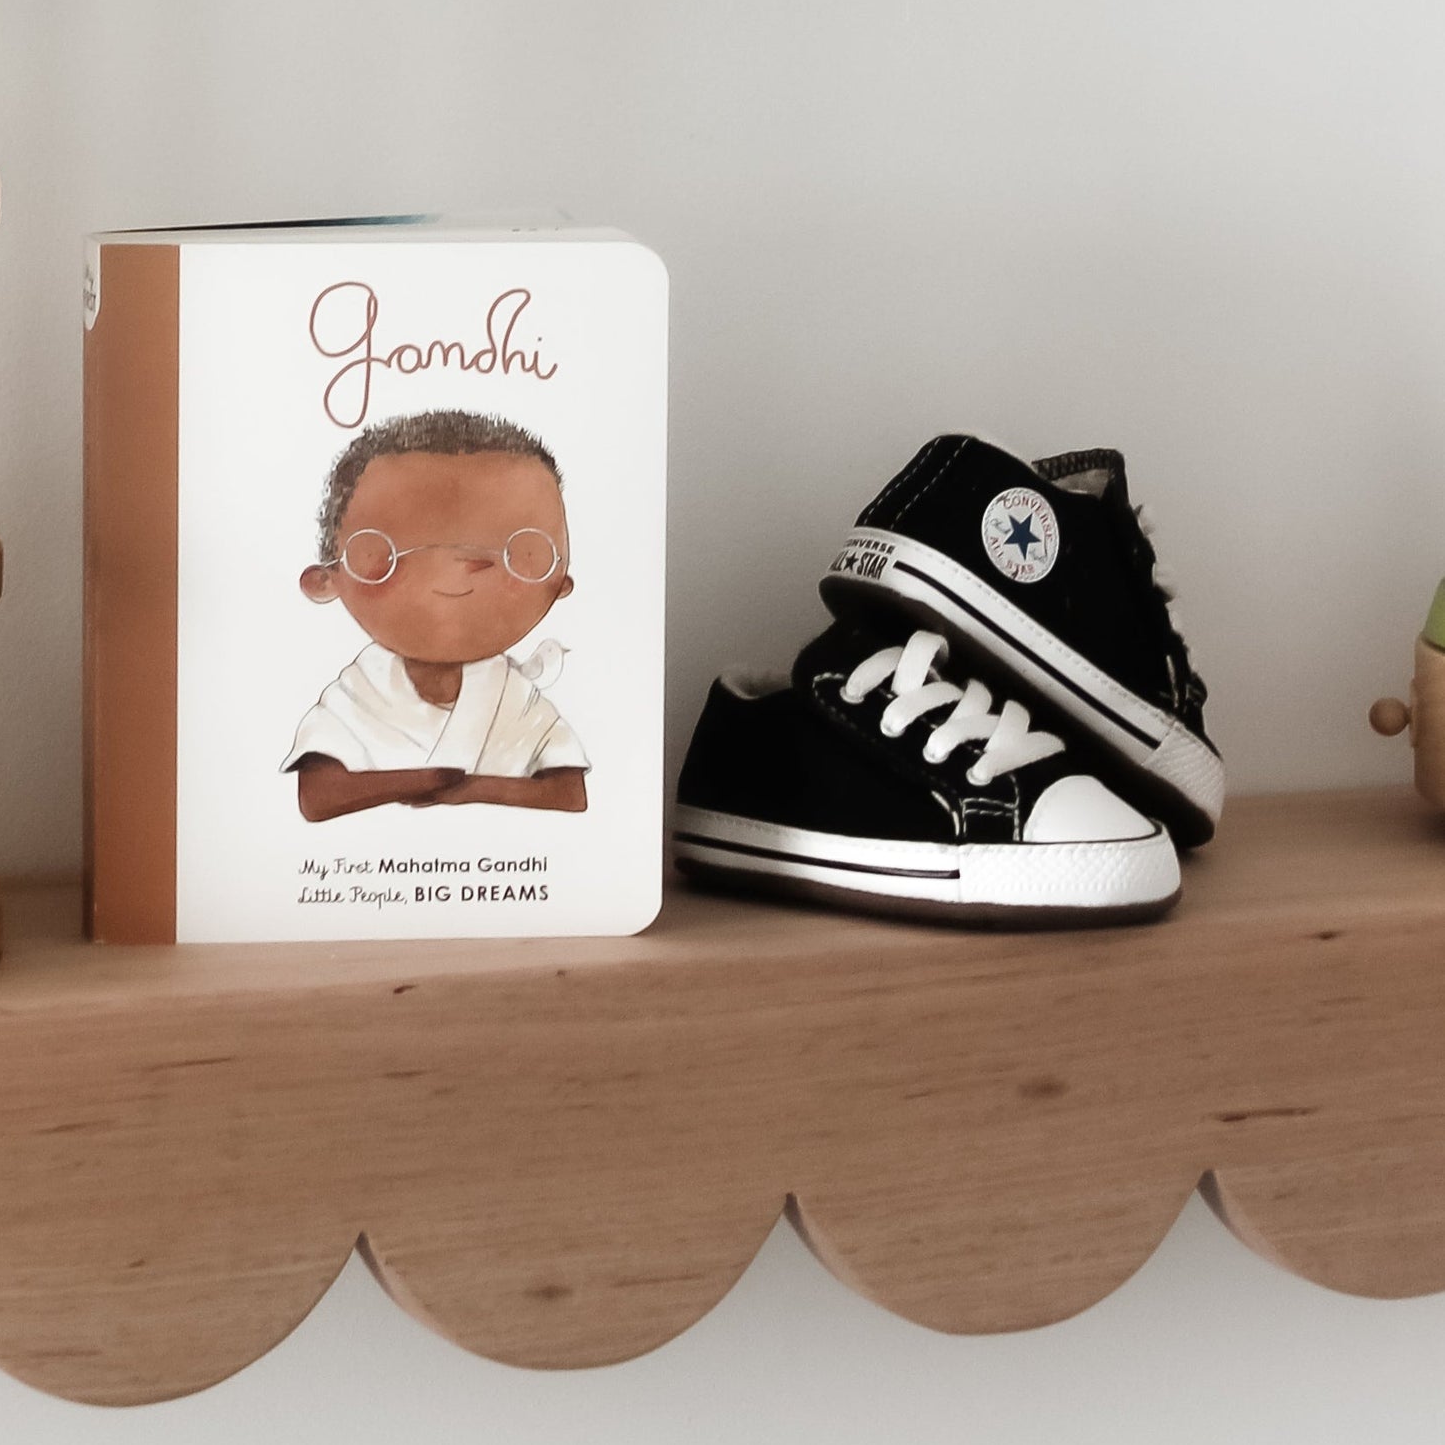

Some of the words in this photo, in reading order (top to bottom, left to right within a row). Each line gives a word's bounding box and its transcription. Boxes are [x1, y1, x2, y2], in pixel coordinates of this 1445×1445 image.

[856, 551, 889, 580] STAR
[298, 858, 329, 881] My
[332, 857, 374, 874] First
[378, 857, 471, 874] Mahatma
[477, 856, 548, 874] Gandhi
[297, 886, 345, 904] Little
[349, 886, 408, 910] People,
[414, 885, 452, 902] BIG
[461, 884, 549, 902] DREAMS
